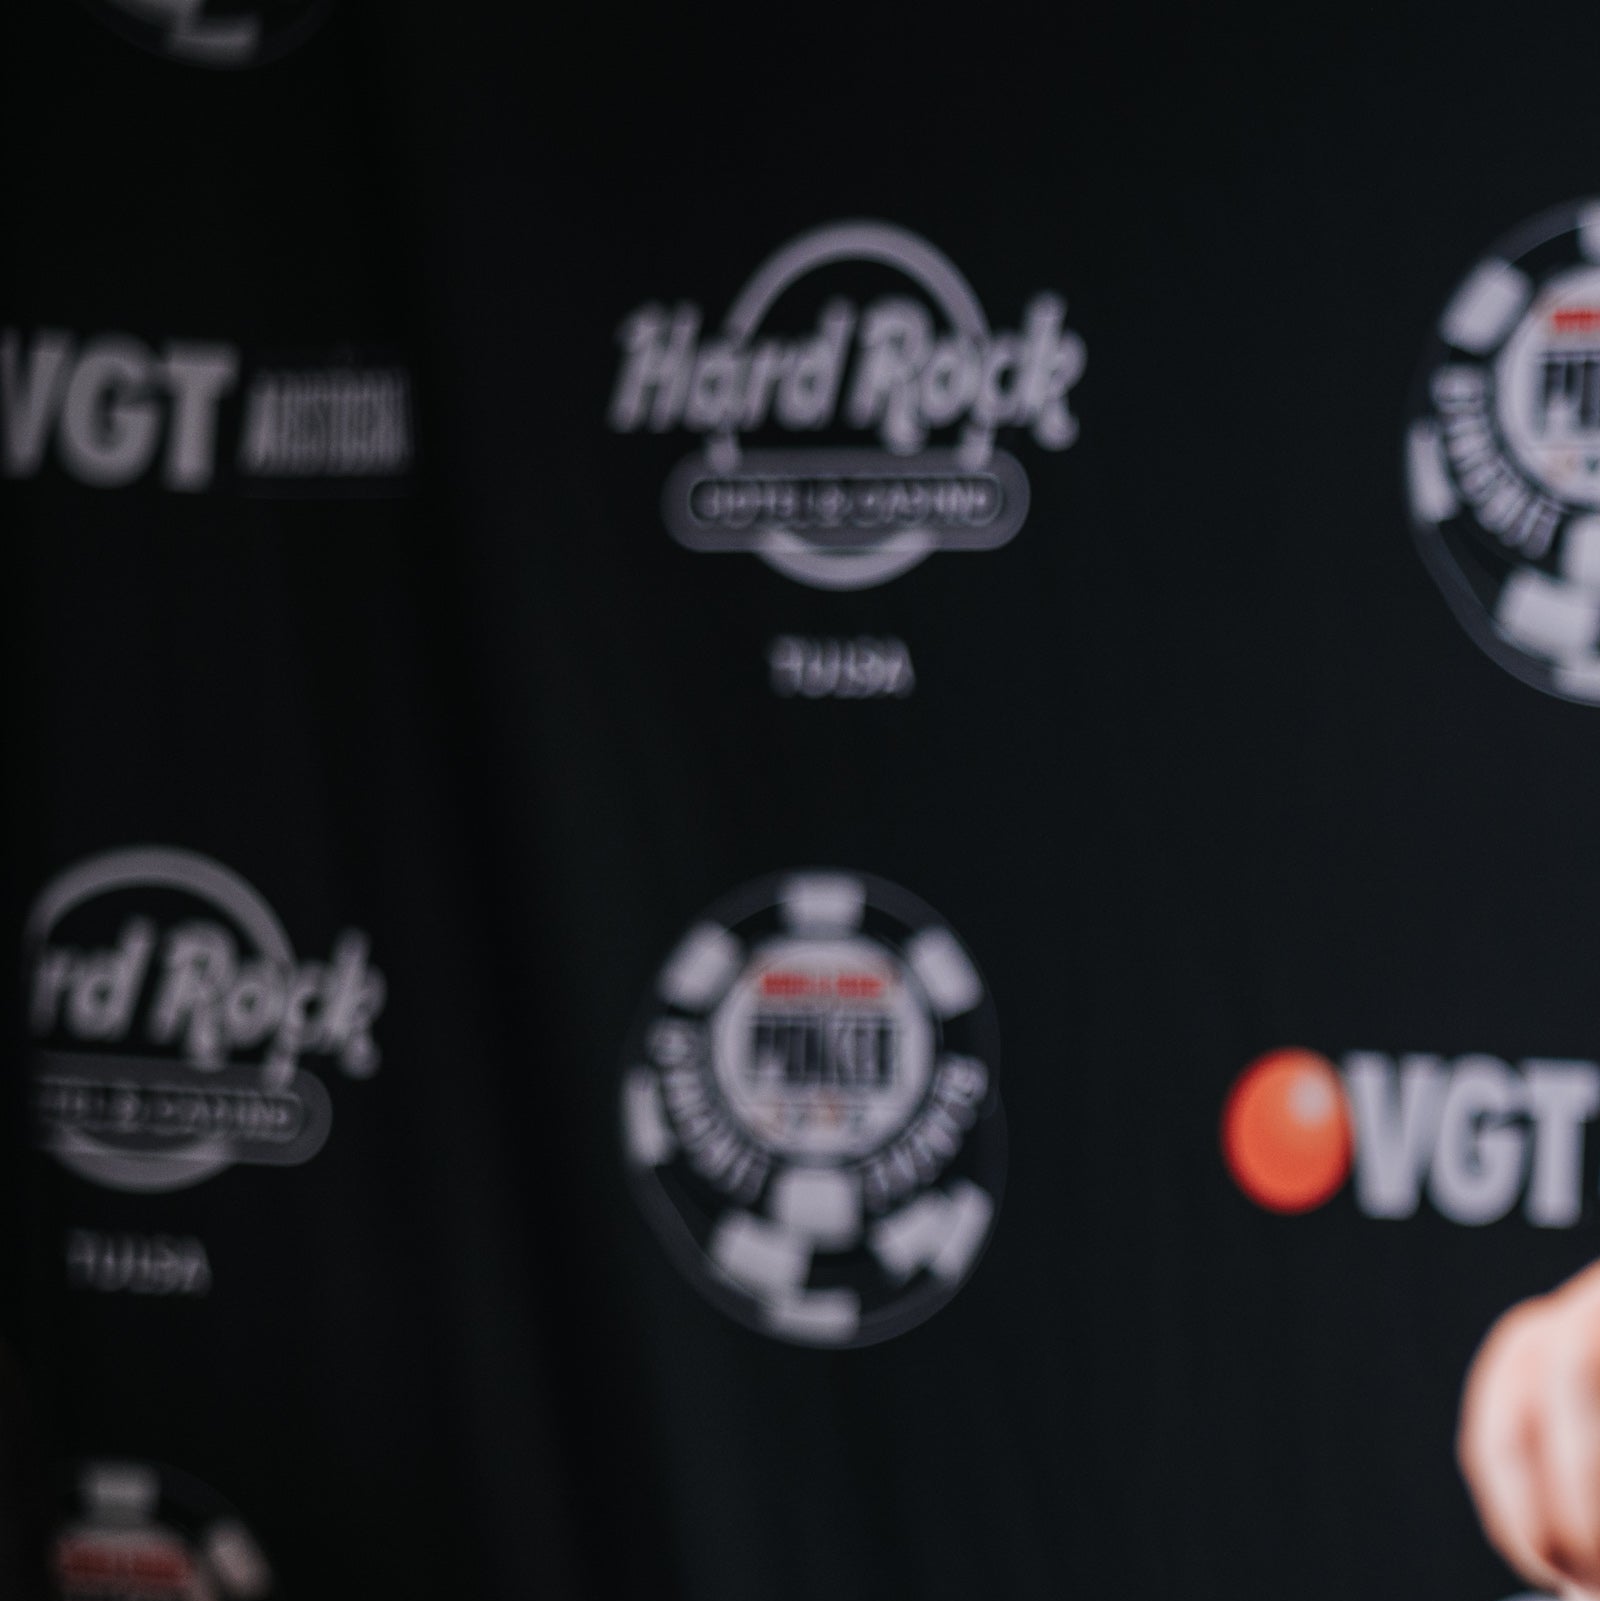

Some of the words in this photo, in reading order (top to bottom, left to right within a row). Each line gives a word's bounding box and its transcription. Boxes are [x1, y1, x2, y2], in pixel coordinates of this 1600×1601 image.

[0, 325, 240, 494] VGT
[605, 298, 857, 434] Hard
[843, 290, 1088, 452] Rock
[28, 914, 158, 1042] rd
[145, 916, 388, 1082] Rock
